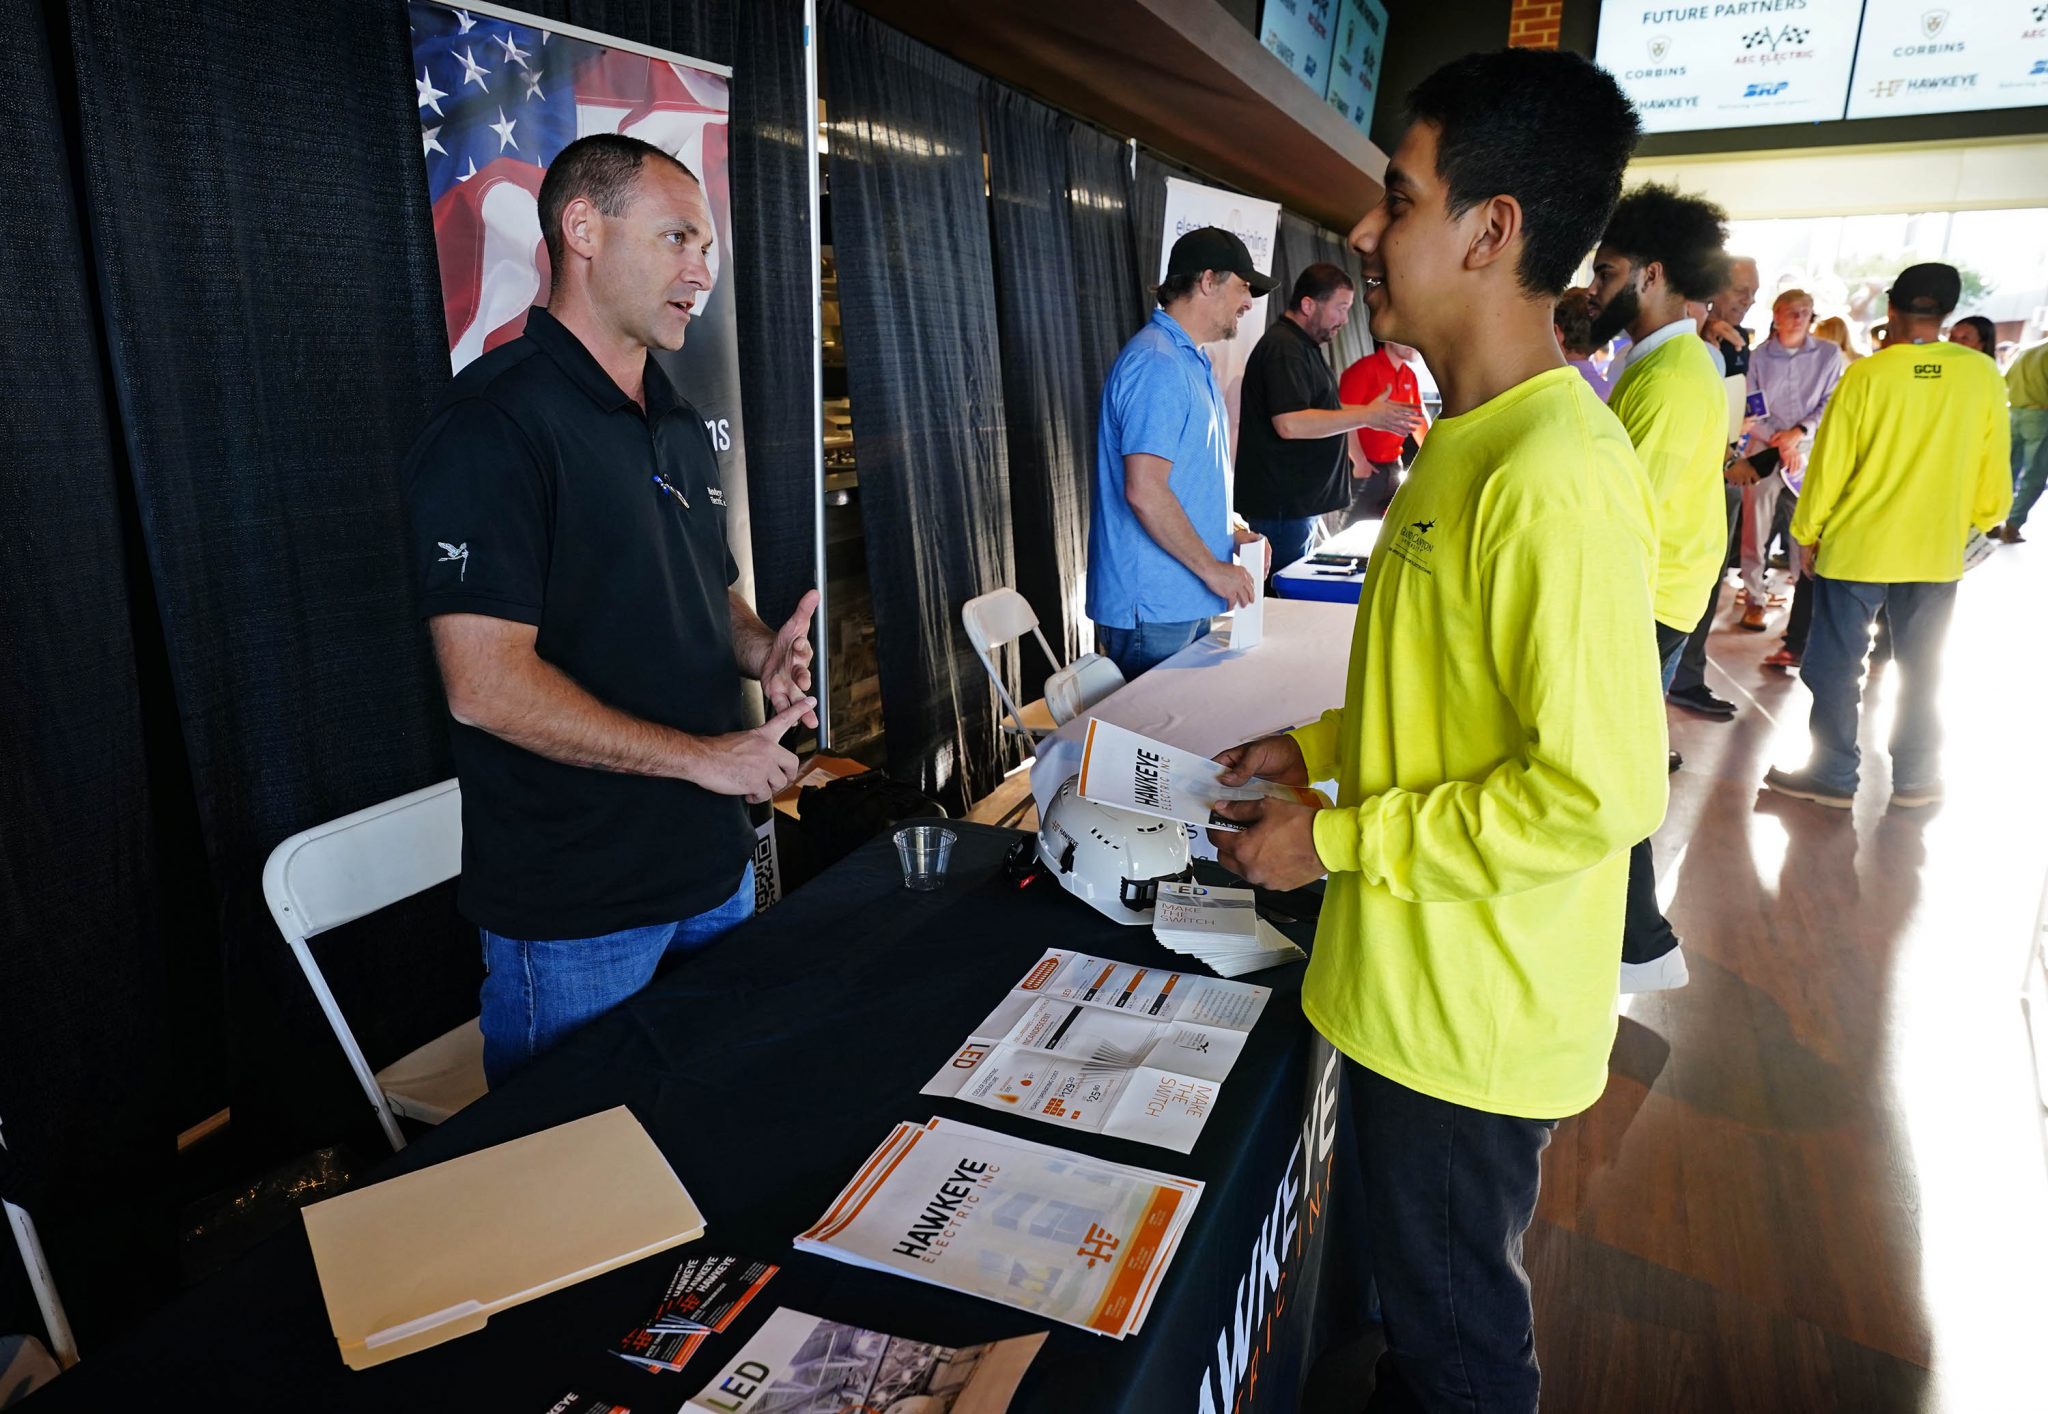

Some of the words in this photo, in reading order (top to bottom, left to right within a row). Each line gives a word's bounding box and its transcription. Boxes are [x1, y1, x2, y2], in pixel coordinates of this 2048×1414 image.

[1643, 6, 1709, 24] FUTURE
[1714, 0, 1807, 17] PARTNERS
[1893, 41, 1965, 57] CORBINS
[1625, 66, 1687, 80] CORBINS
[1907, 73, 1979, 90] HAWKEYE
[1639, 96, 1699, 110] HAWKEYE
[1914, 364, 1941, 374] GCU
[1135, 748, 1159, 808] HAWKEYE
[1160, 914, 1215, 926] SWITCH
[1162, 903, 1203, 913] MAKE
[952, 1043, 990, 1069] LED
[1145, 1076, 1177, 1118] SWITCH
[1171, 1083, 1195, 1105] THE
[1186, 1085, 1212, 1118] MAKE
[892, 1158, 987, 1258] HAWKEYE
[922, 1195, 979, 1264] ELECTRIC
[977, 1164, 1000, 1189] INC
[696, 1256, 736, 1292] HAWKEYE
[706, 1361, 770, 1412] LED
